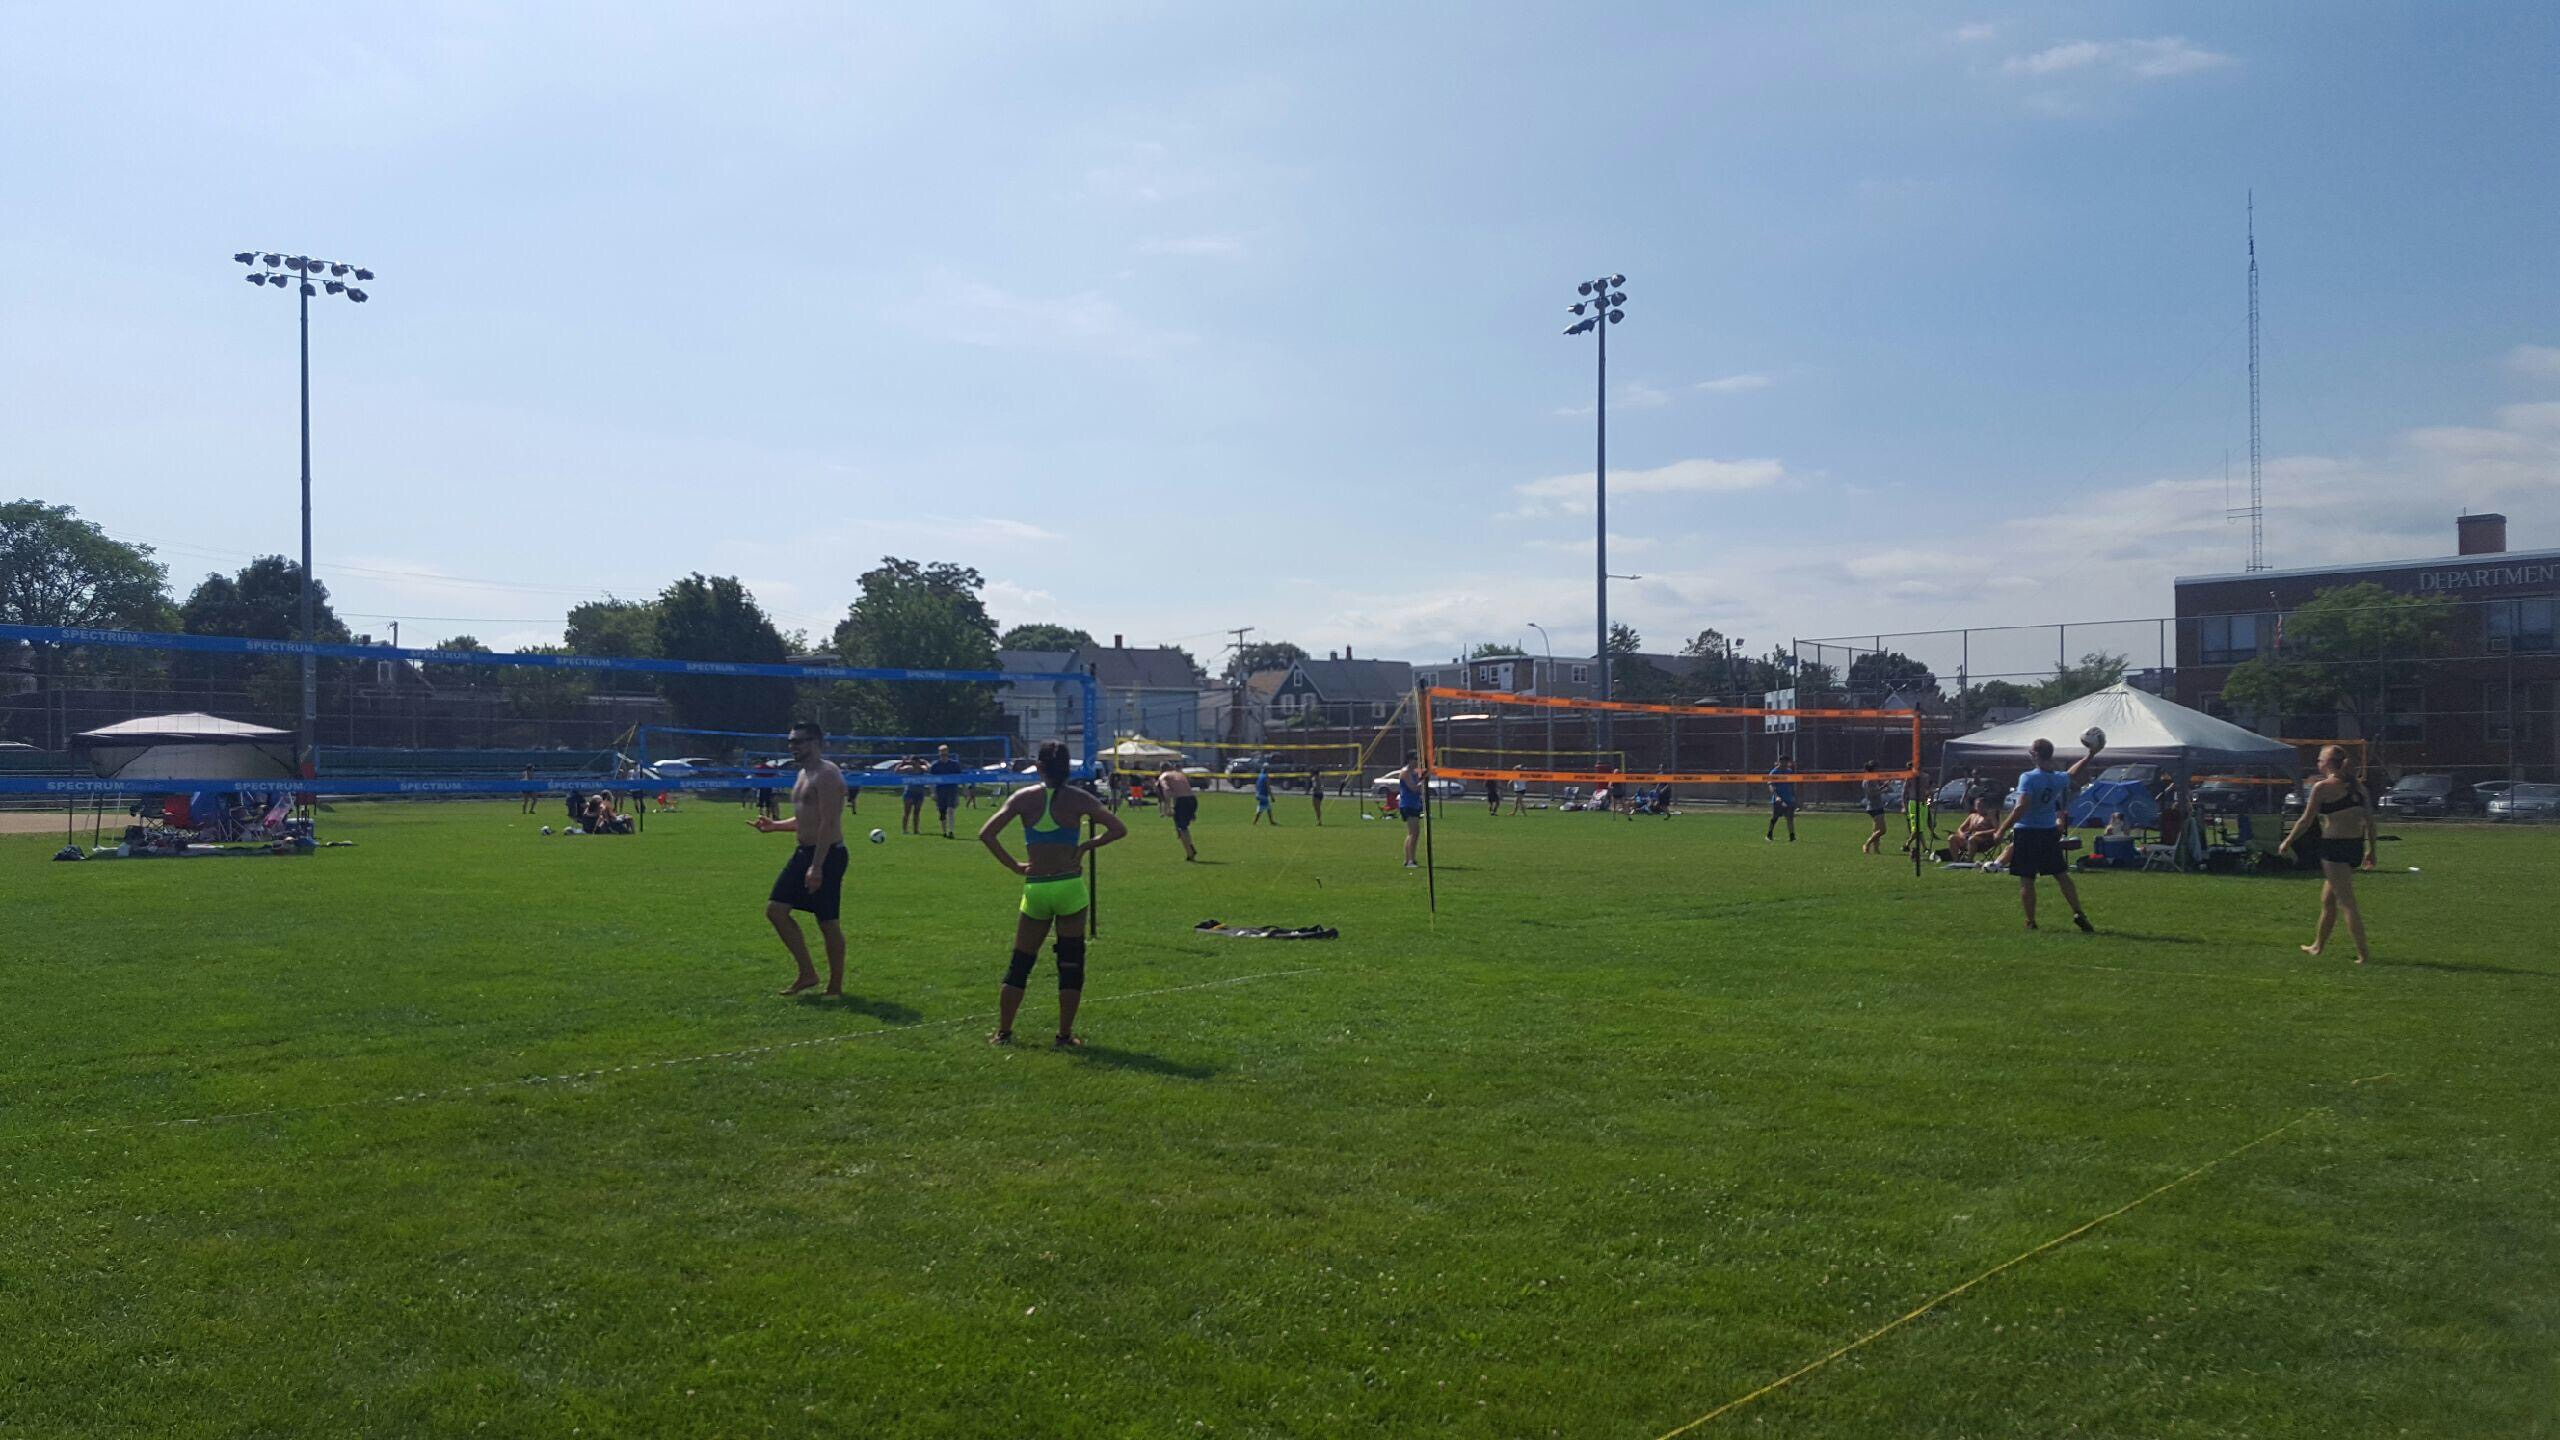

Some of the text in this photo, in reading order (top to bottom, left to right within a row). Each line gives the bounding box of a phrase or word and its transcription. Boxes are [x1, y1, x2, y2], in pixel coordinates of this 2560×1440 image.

[61, 629, 138, 643] SPECTRUM
[246, 641, 314, 653] SPECTRUM
[409, 650, 472, 661] SPECTRUM
[556, 657, 611, 667] SPECTRUM
[686, 662, 736, 672] SPECTRUM
[47, 781, 124, 790] SPECTRUM
[234, 782, 303, 791] SPECTRUM
[400, 782, 462, 790] SPECTRUM
